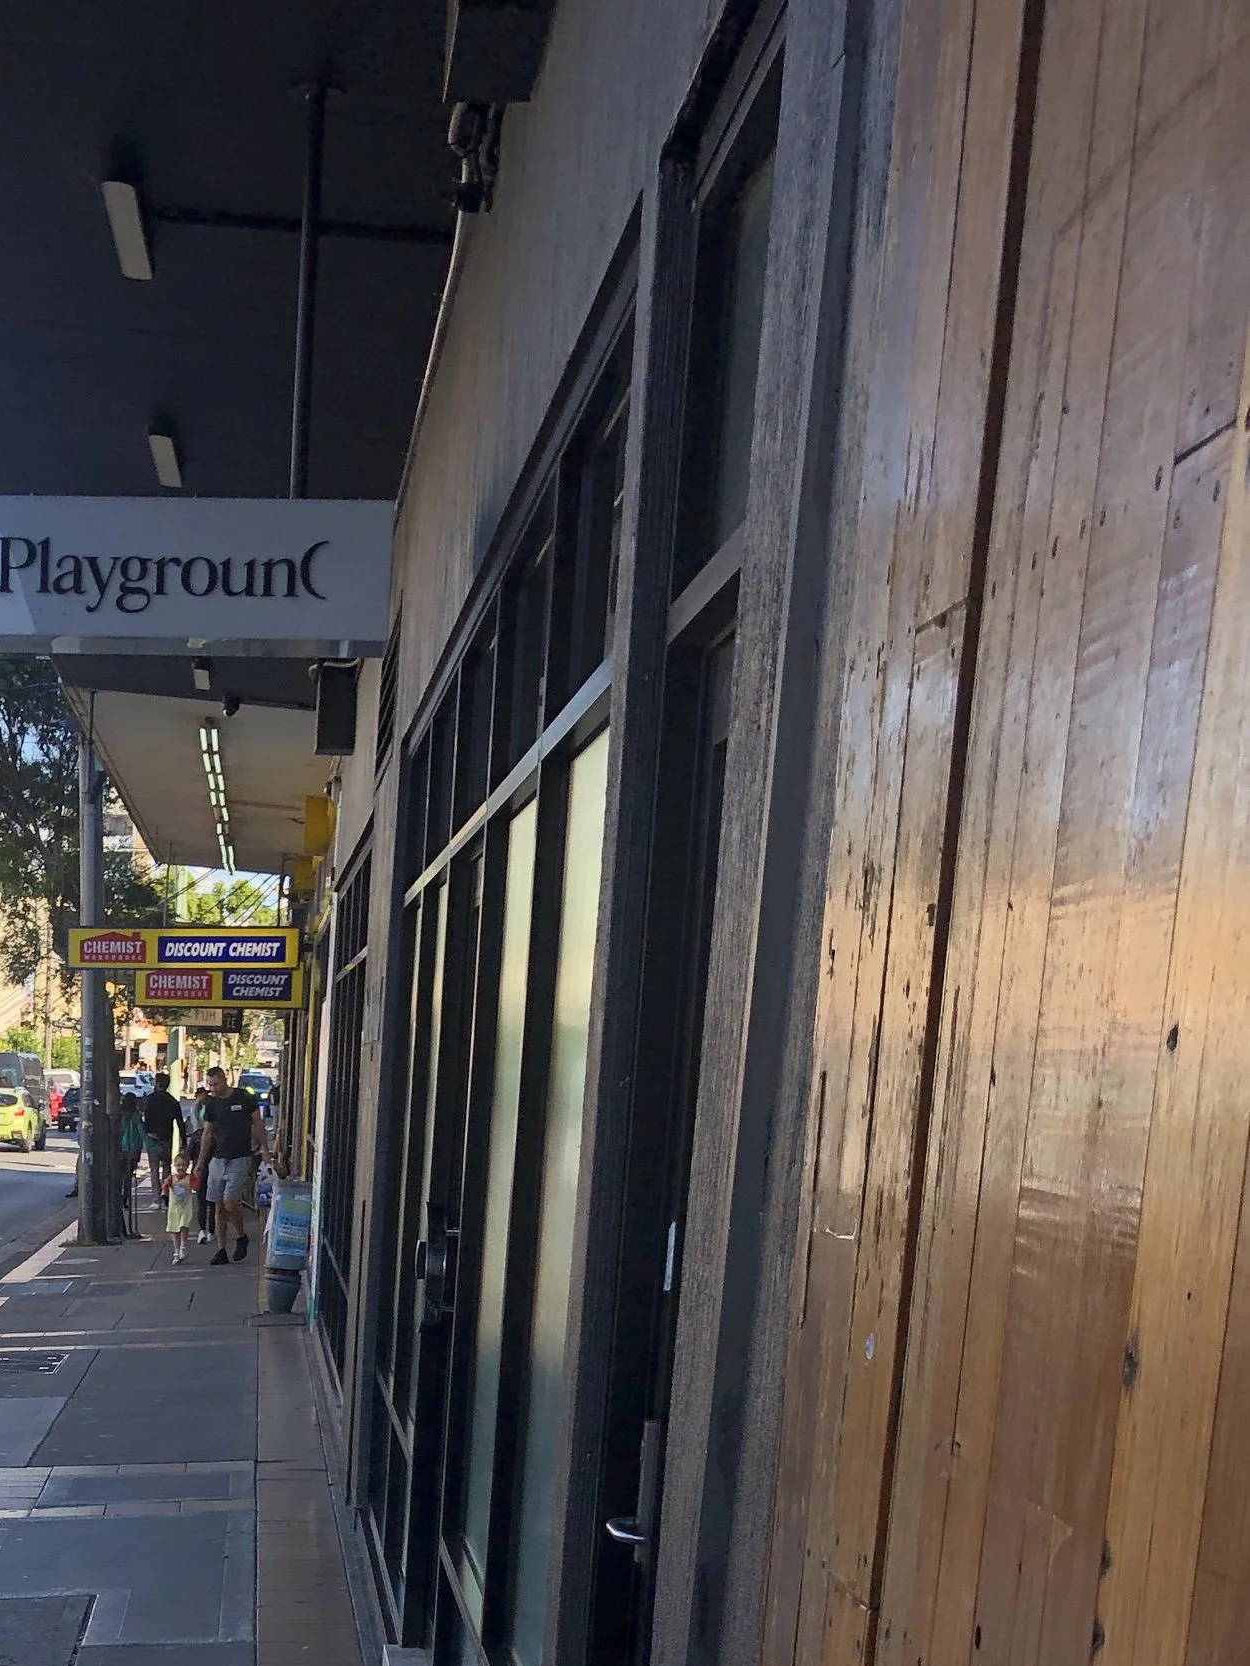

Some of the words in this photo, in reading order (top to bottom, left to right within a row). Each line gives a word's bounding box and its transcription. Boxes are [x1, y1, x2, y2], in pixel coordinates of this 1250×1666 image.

[83, 940, 142, 954] CHEMIST
[165, 942, 225, 957] DISCOUNT
[228, 942, 281, 957] CHEMIST
[150, 975, 209, 989] CHEMIST
[228, 974, 288, 985] DISCOUNT
[232, 987, 283, 997] CHEMIST
